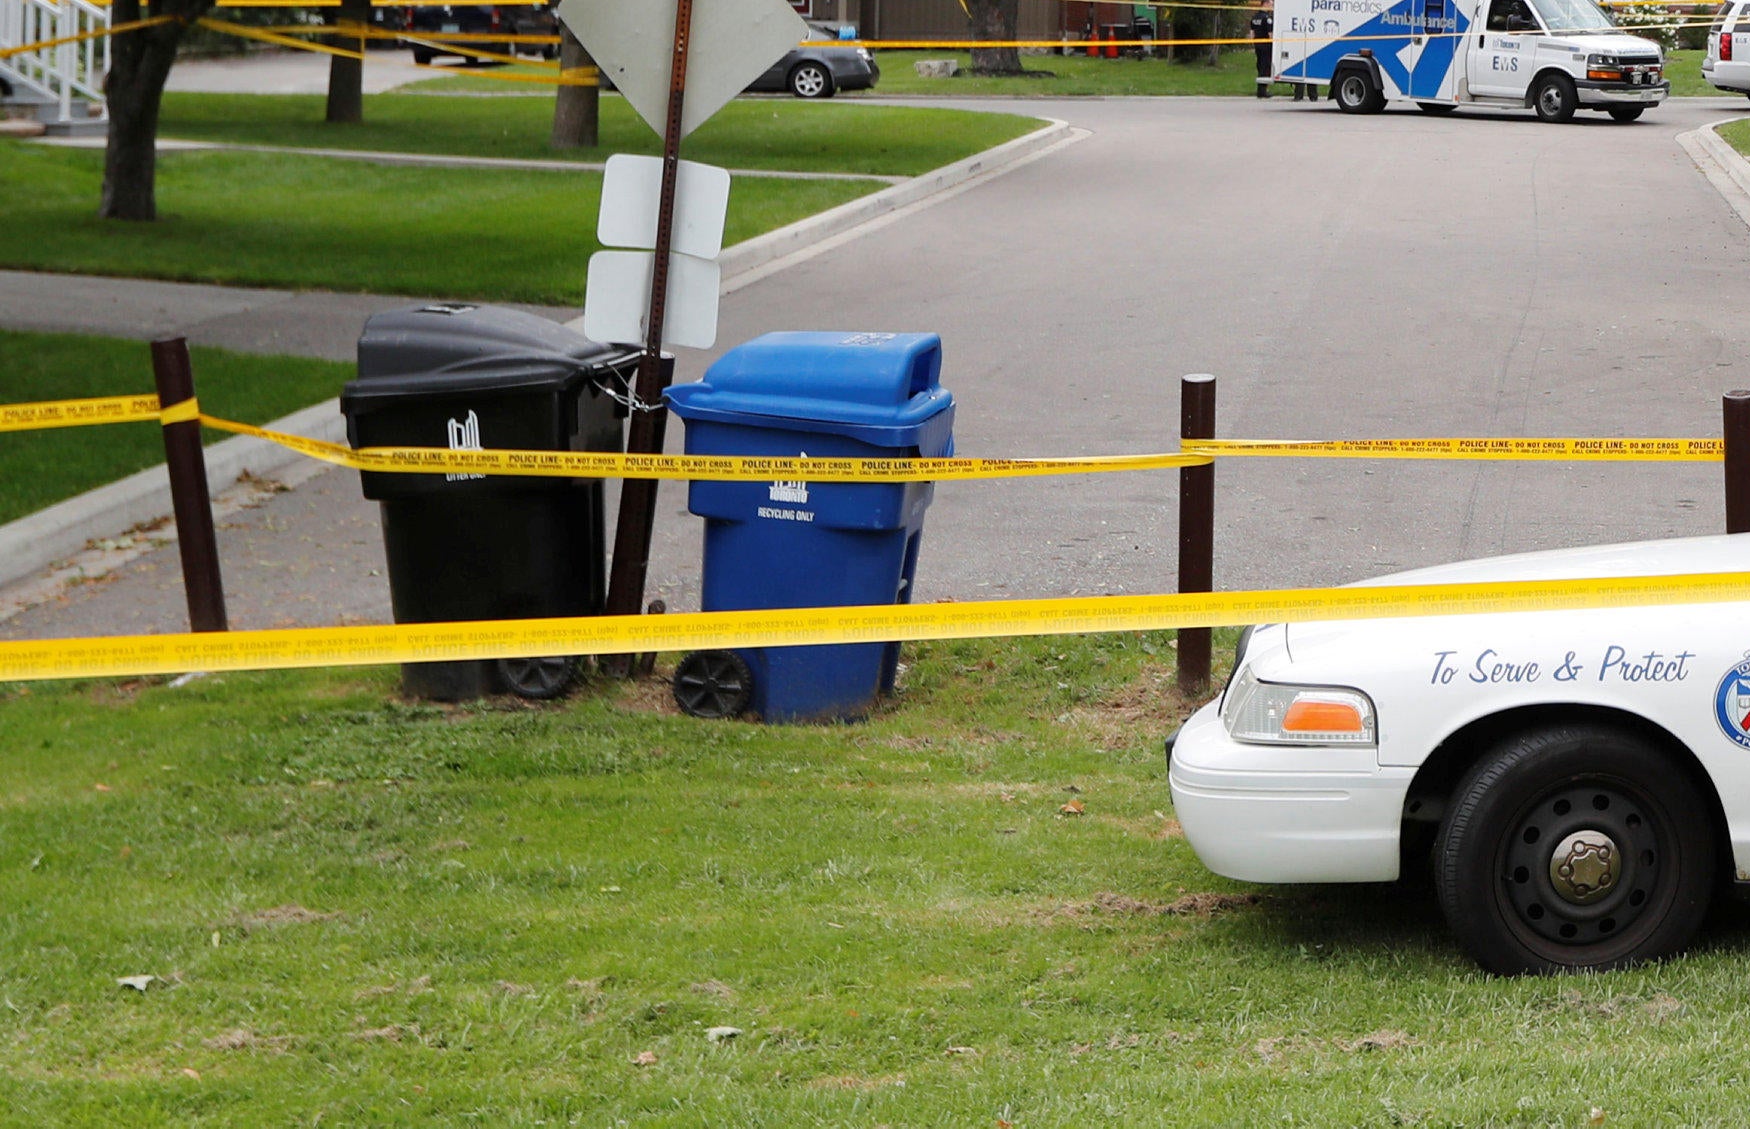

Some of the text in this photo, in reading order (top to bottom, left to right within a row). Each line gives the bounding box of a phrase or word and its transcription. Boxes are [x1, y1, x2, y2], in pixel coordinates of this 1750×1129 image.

[1381, 11, 1456, 29] Ambulance
[1460, 440, 1488, 448] POLICE
[509, 455, 536, 463] POLICE
[626, 458, 653, 466] POLICE
[693, 460, 706, 468] NOT
[742, 460, 771, 468] POLICE
[862, 462, 892, 470] POLICE
[757, 507, 815, 522] RECYCLING ONLY
[1431, 645, 1696, 684] To Serve & Protect
